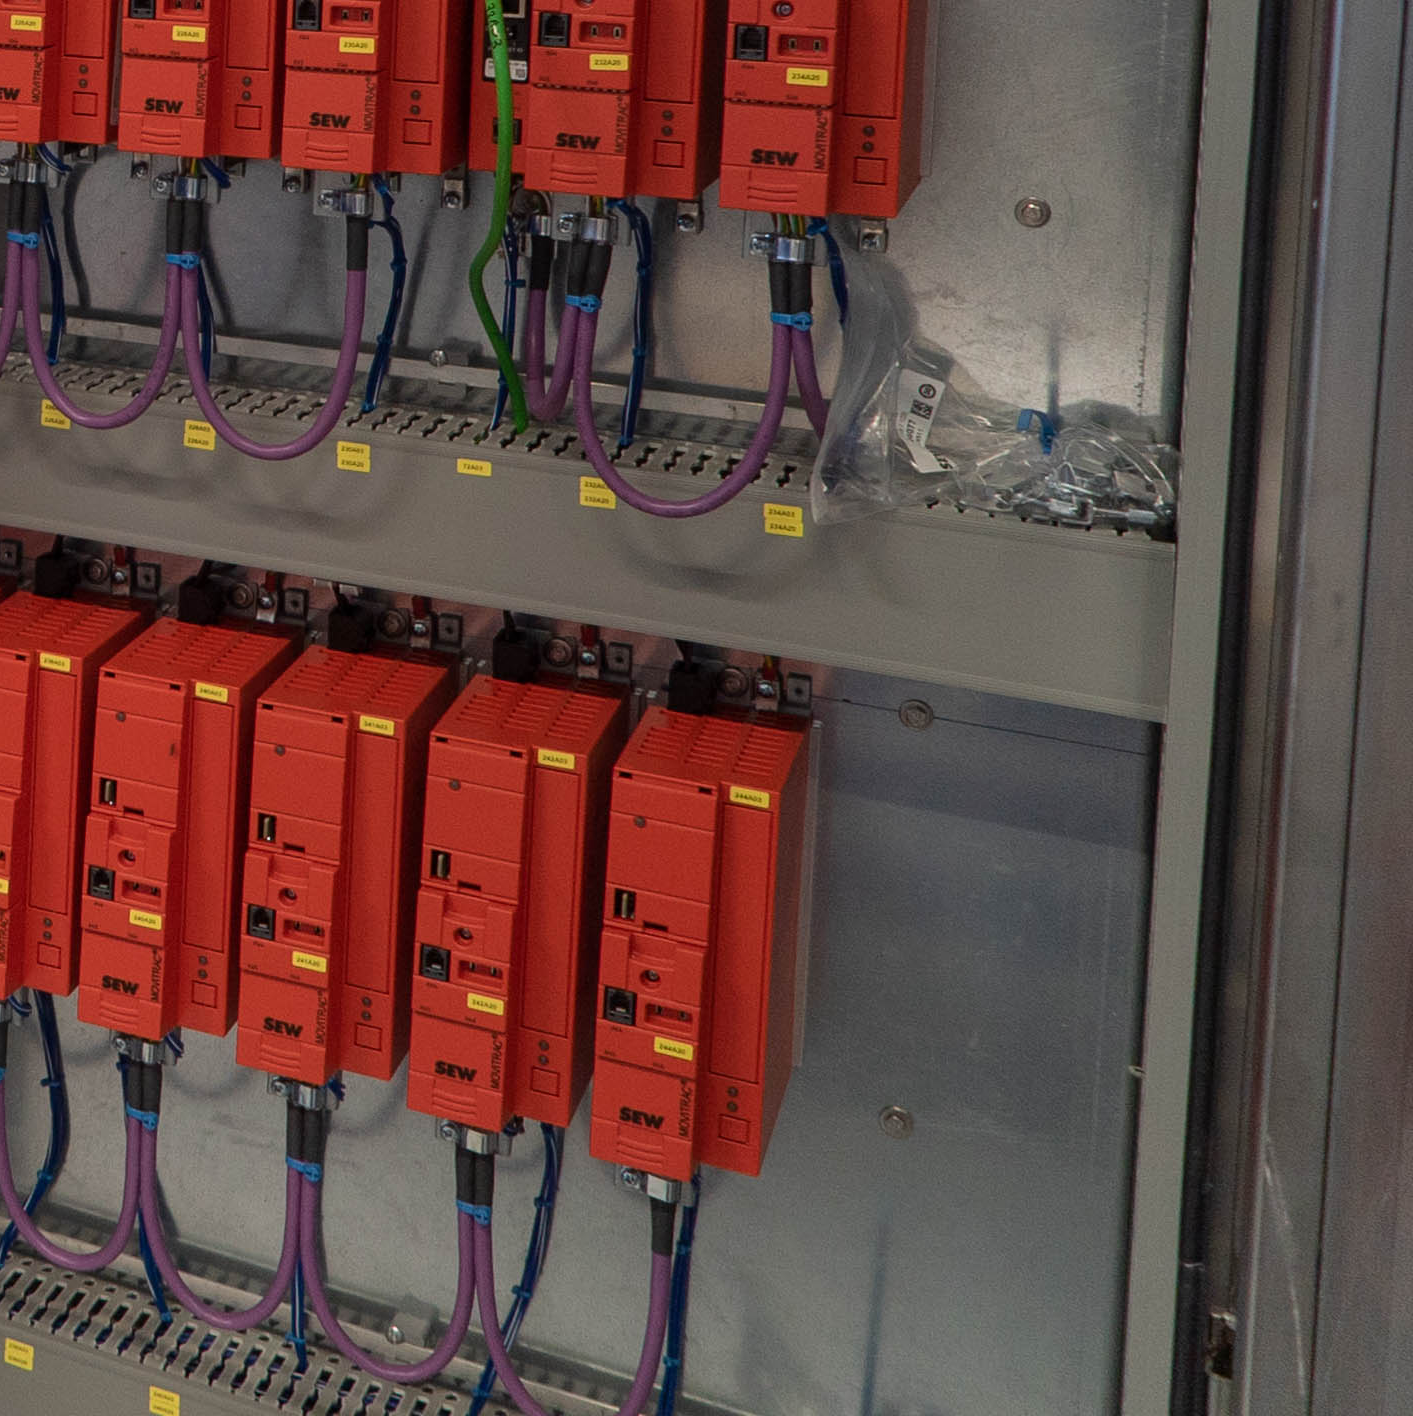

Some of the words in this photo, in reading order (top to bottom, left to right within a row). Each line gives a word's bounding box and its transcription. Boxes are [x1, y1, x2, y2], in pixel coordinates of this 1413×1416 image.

[145, 98, 183, 114] SEW
[309, 112, 350, 129] SEW
[556, 133, 600, 150] SEW
[751, 149, 798, 166] SEW
[102, 976, 139, 995] SEW
[264, 1017, 302, 1037] SEW
[435, 1061, 477, 1081] SEW
[620, 1107, 664, 1129] SEW
